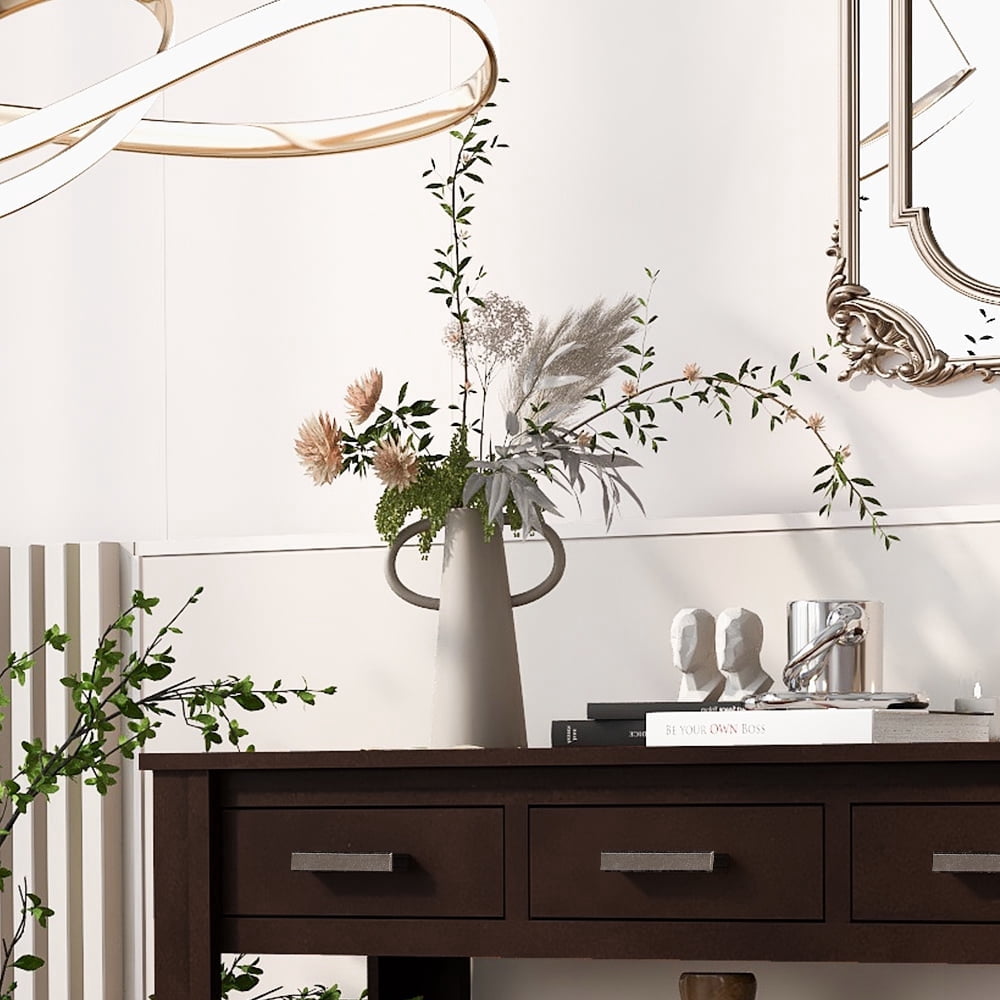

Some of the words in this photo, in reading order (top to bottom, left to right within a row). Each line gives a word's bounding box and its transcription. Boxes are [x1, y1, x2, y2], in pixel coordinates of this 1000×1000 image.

[666, 724, 676, 735] BE
[680, 724, 708, 735] YOUR
[709, 723, 738, 735] OWN
[741, 723, 767, 735] BOSS
